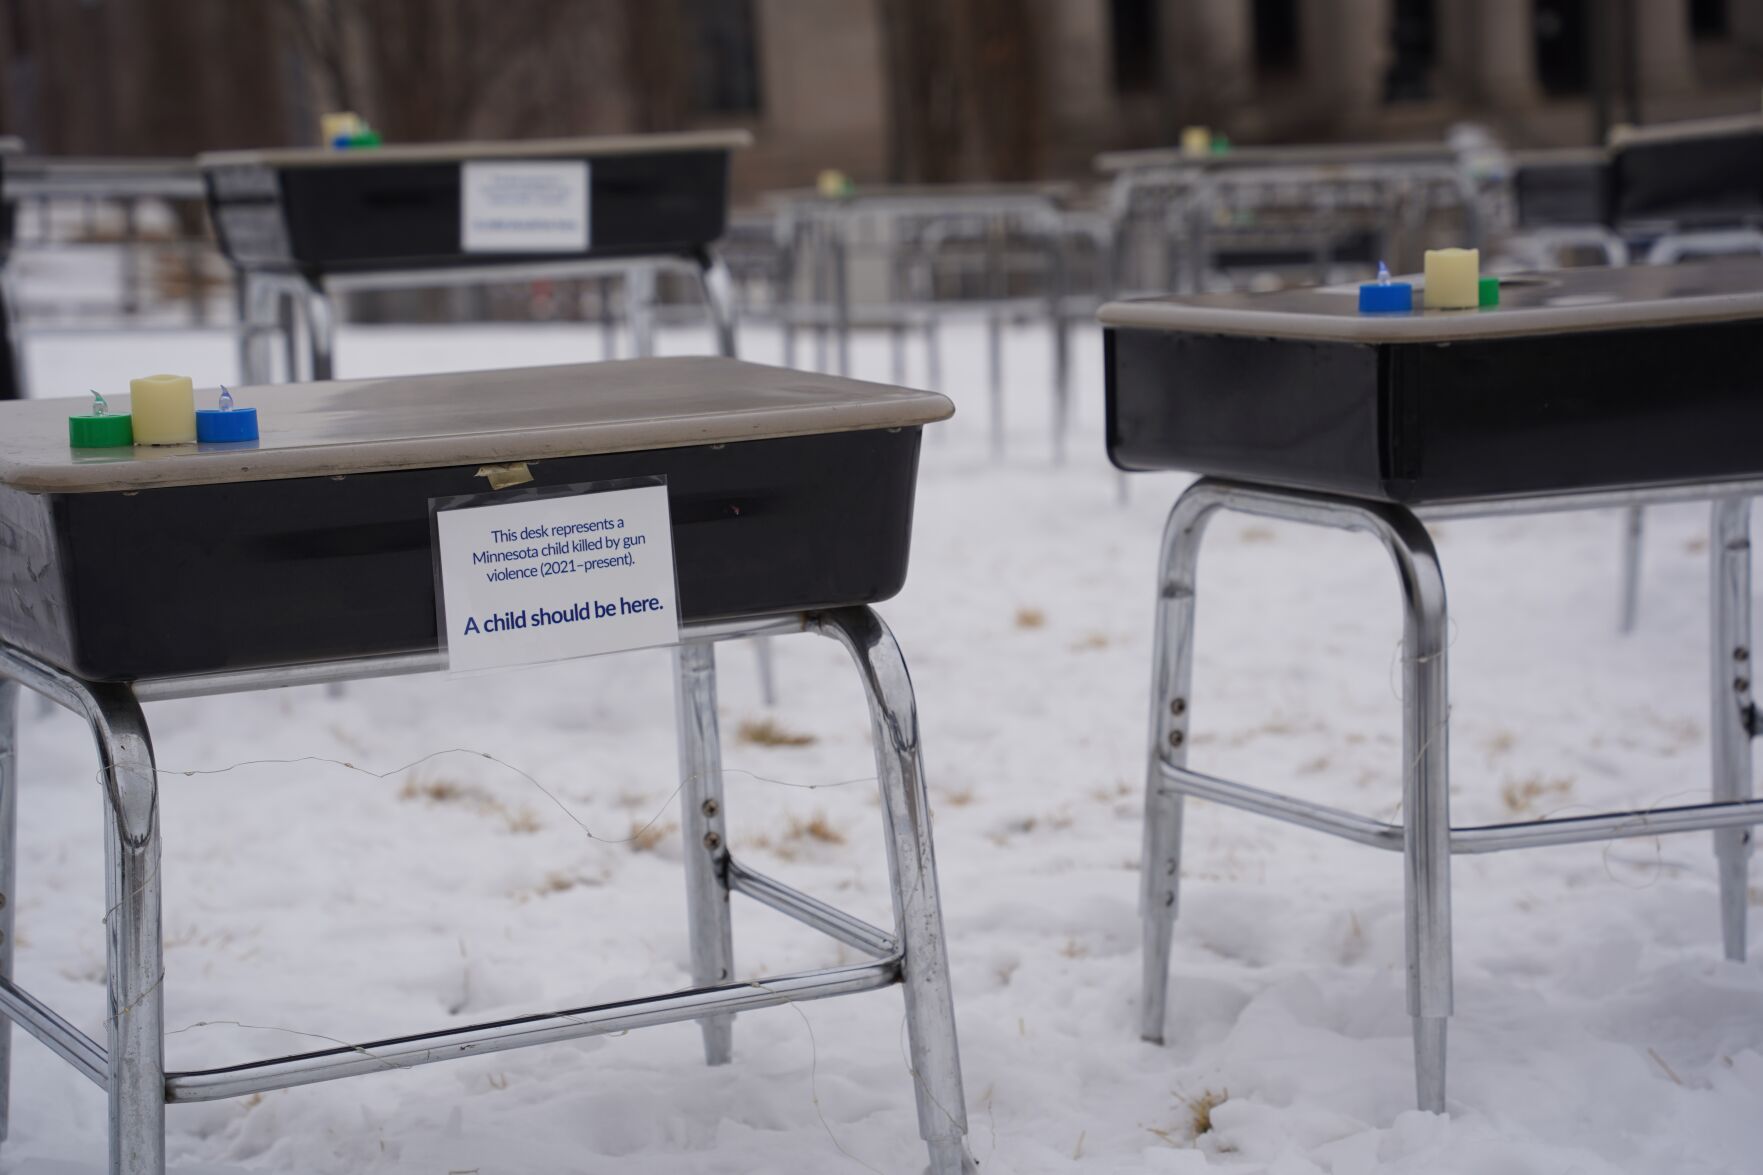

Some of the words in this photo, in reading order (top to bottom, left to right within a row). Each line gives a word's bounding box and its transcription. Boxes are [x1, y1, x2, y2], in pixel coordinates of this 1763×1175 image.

[490, 529, 518, 543] This
[520, 524, 549, 540] desk
[551, 518, 615, 538] represents
[617, 518, 625, 529] a
[472, 546, 539, 565] Minnesota
[541, 541, 570, 557] child
[572, 536, 603, 553] killed
[605, 536, 621, 550] by
[623, 535, 646, 549] gun
[486, 567, 538, 582] violence
[464, 616, 481, 636] A
[483, 609, 527, 633] child
[530, 601, 591, 627] should
[594, 600, 617, 619] be
[620, 596, 664, 615] here.
